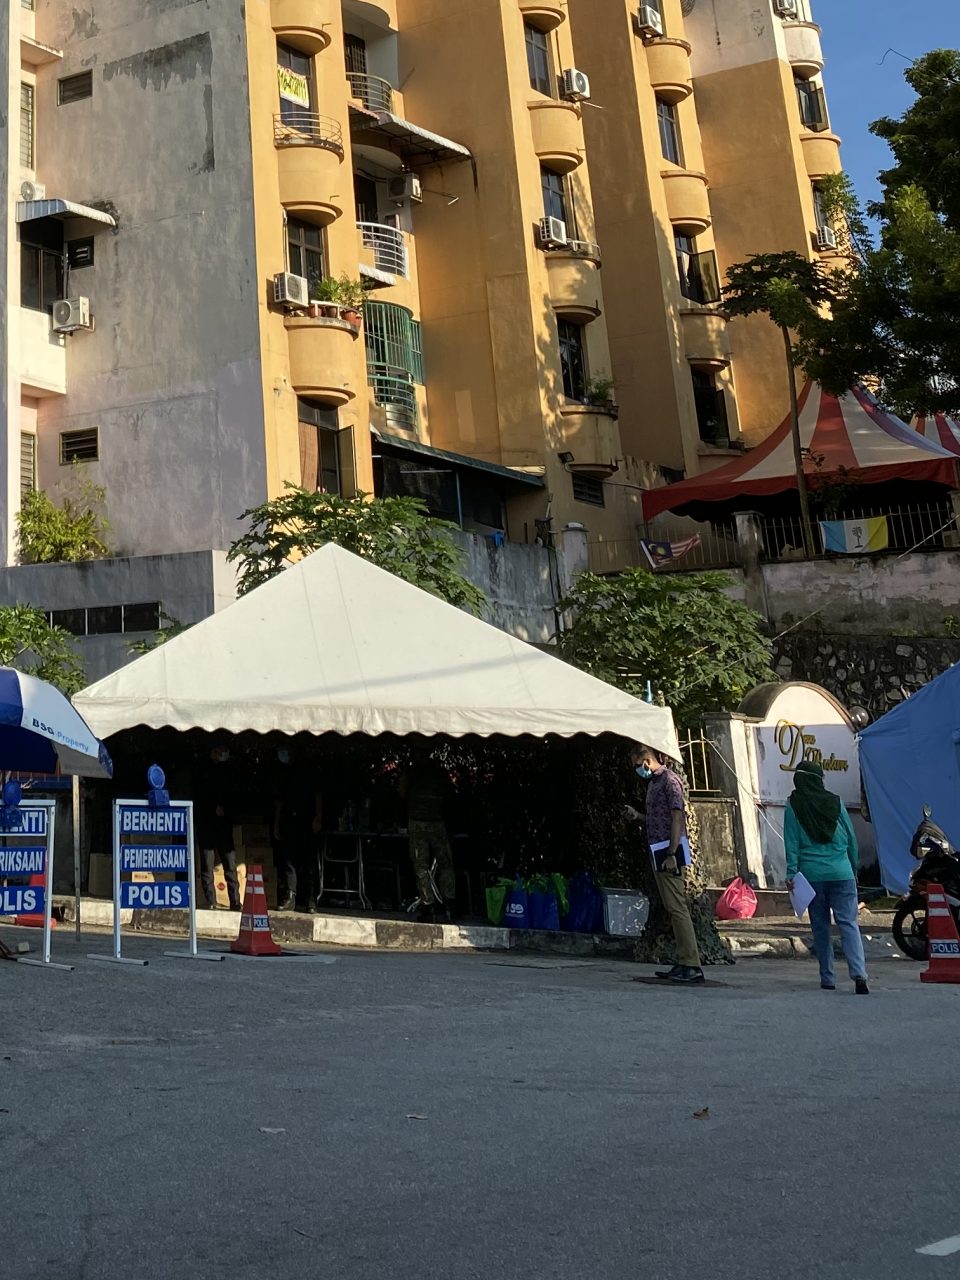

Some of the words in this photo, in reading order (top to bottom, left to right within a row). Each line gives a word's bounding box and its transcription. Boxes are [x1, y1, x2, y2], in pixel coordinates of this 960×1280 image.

[57, 730, 90, 752] Property
[123, 811, 185, 832] BERHENTI
[124, 848, 186, 869] PEMERIKSAAN
[128, 885, 182, 905] POLIS
[253, 918, 269, 927] POLIS
[932, 943, 959, 953] POLIS
